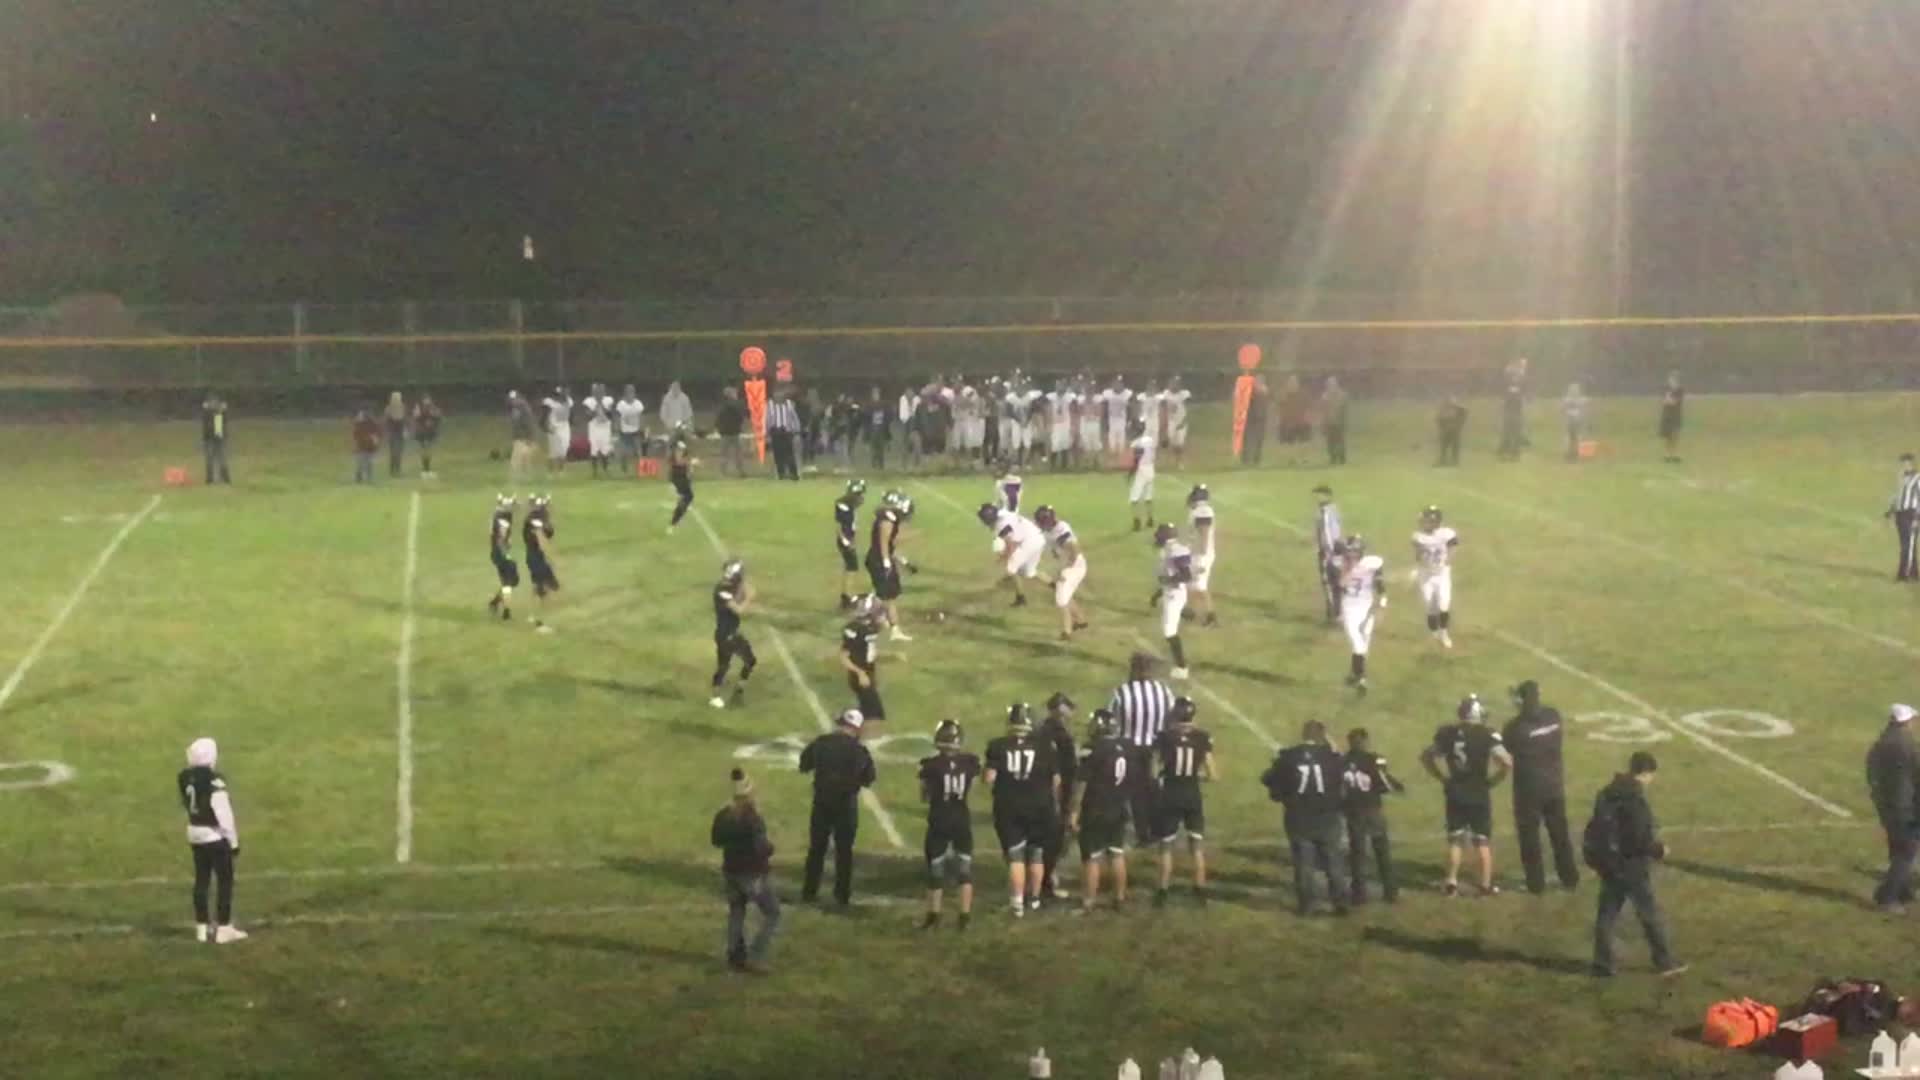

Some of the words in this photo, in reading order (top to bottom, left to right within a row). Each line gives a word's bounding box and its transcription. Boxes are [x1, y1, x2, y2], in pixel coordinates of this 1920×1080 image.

[776, 359, 793, 382] 2
[1574, 708, 1795, 743] 30
[1006, 749, 1035, 781] 47
[1114, 756, 1127, 786] 9
[1175, 746, 1194, 777] 11
[943, 772, 967, 802] 14
[1297, 763, 1325, 794] 71
[185, 784, 198, 814] 2
